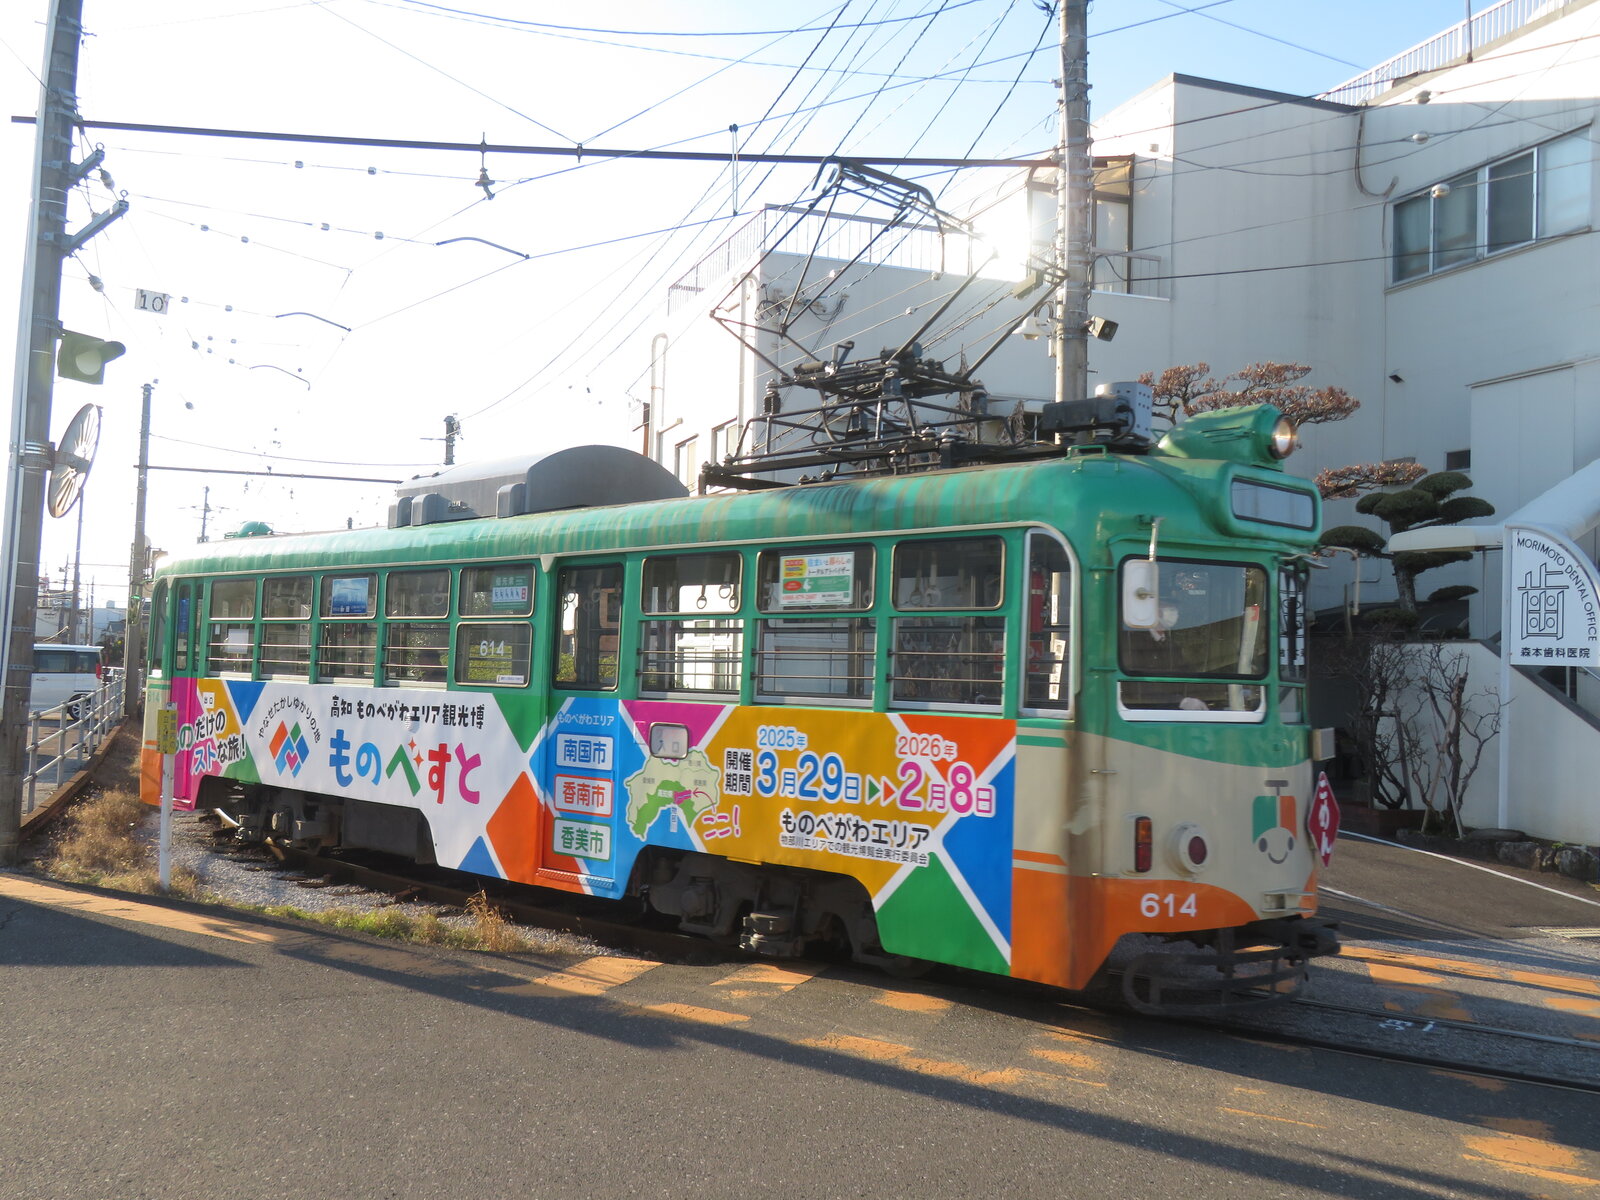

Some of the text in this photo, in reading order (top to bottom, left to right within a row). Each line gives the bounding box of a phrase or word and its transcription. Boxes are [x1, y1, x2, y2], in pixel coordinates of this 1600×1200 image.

[141, 294, 164, 312] 10
[1516, 537, 1598, 641] MORIMOTO DENTAL OFFICE
[480, 640, 505, 657] 614
[1520, 647, 1590, 659] 森本歯科医院
[330, 695, 353, 718] 高知
[258, 695, 322, 744] やなせたかしゆかりの地
[557, 713, 615, 727] ものべがわエリア
[758, 727, 806, 749] 2025年
[898, 736, 955, 758] 2026年
[563, 738, 607, 765] 南国市
[725, 750, 752, 772] 開催
[329, 729, 482, 805] ものべすと
[562, 780, 606, 809] 香南市
[725, 772, 751, 794] 期間
[757, 751, 993, 814] 3月29日 2月8日
[561, 826, 604, 855] 香美市
[782, 811, 930, 850] ものべがわエリア
[1140, 893, 1197, 918] 614
